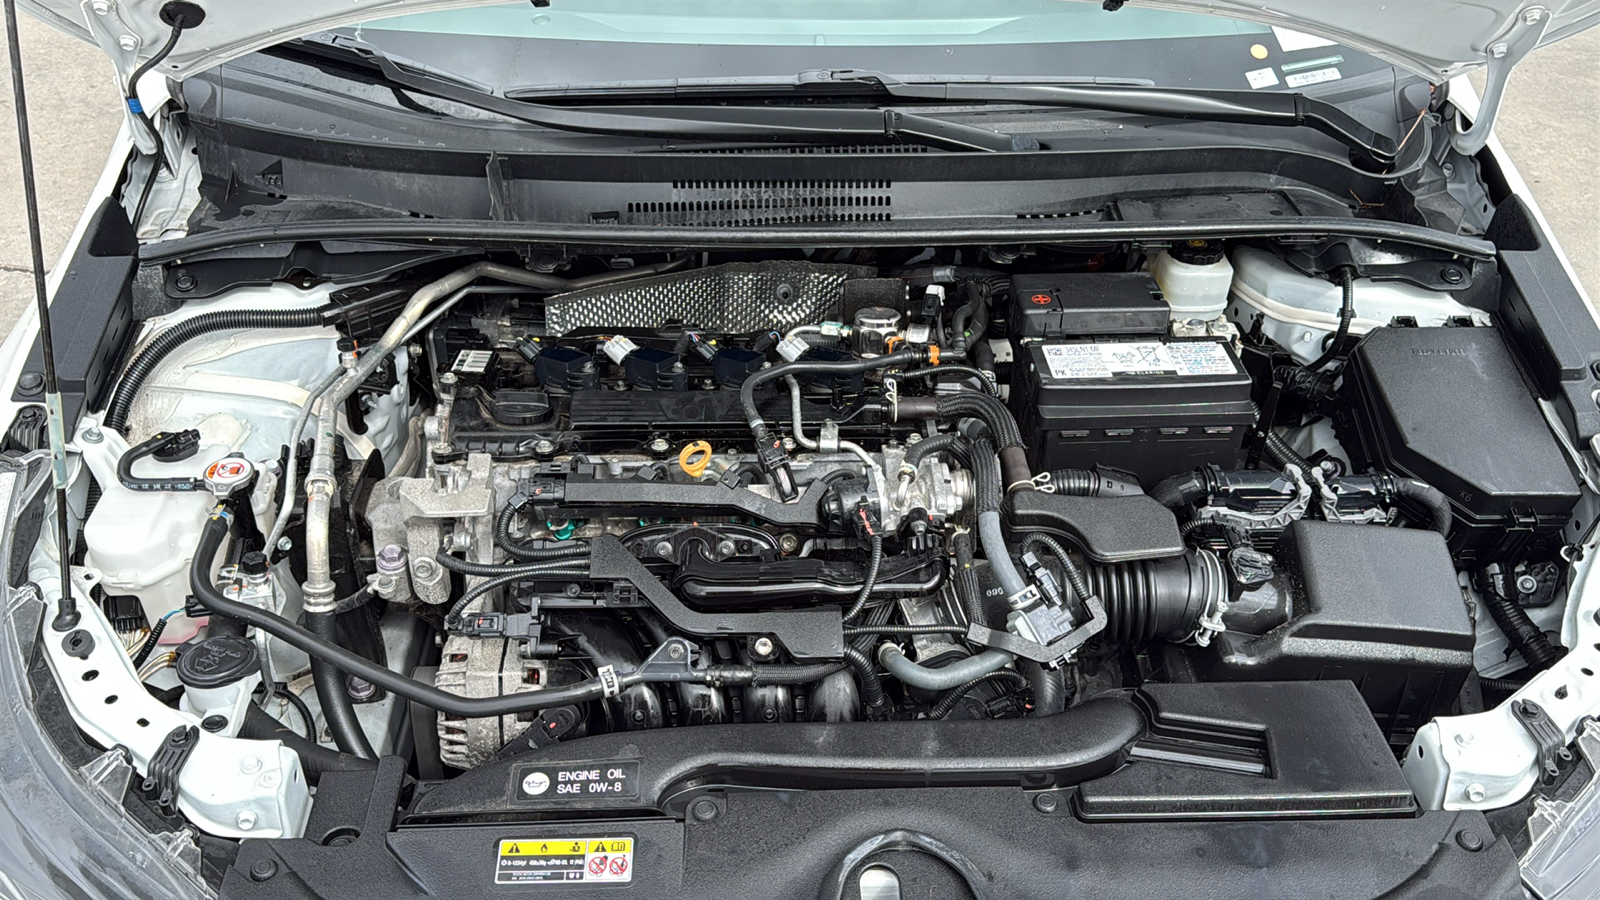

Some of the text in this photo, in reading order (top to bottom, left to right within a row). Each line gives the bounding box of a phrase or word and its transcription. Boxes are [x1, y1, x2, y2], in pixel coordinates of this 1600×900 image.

[1055, 369, 1067, 377] PK
[1459, 489, 1473, 502] K6
[558, 768, 626, 781] ENGINE OIL
[556, 781, 622, 794] SAE 0W-8
